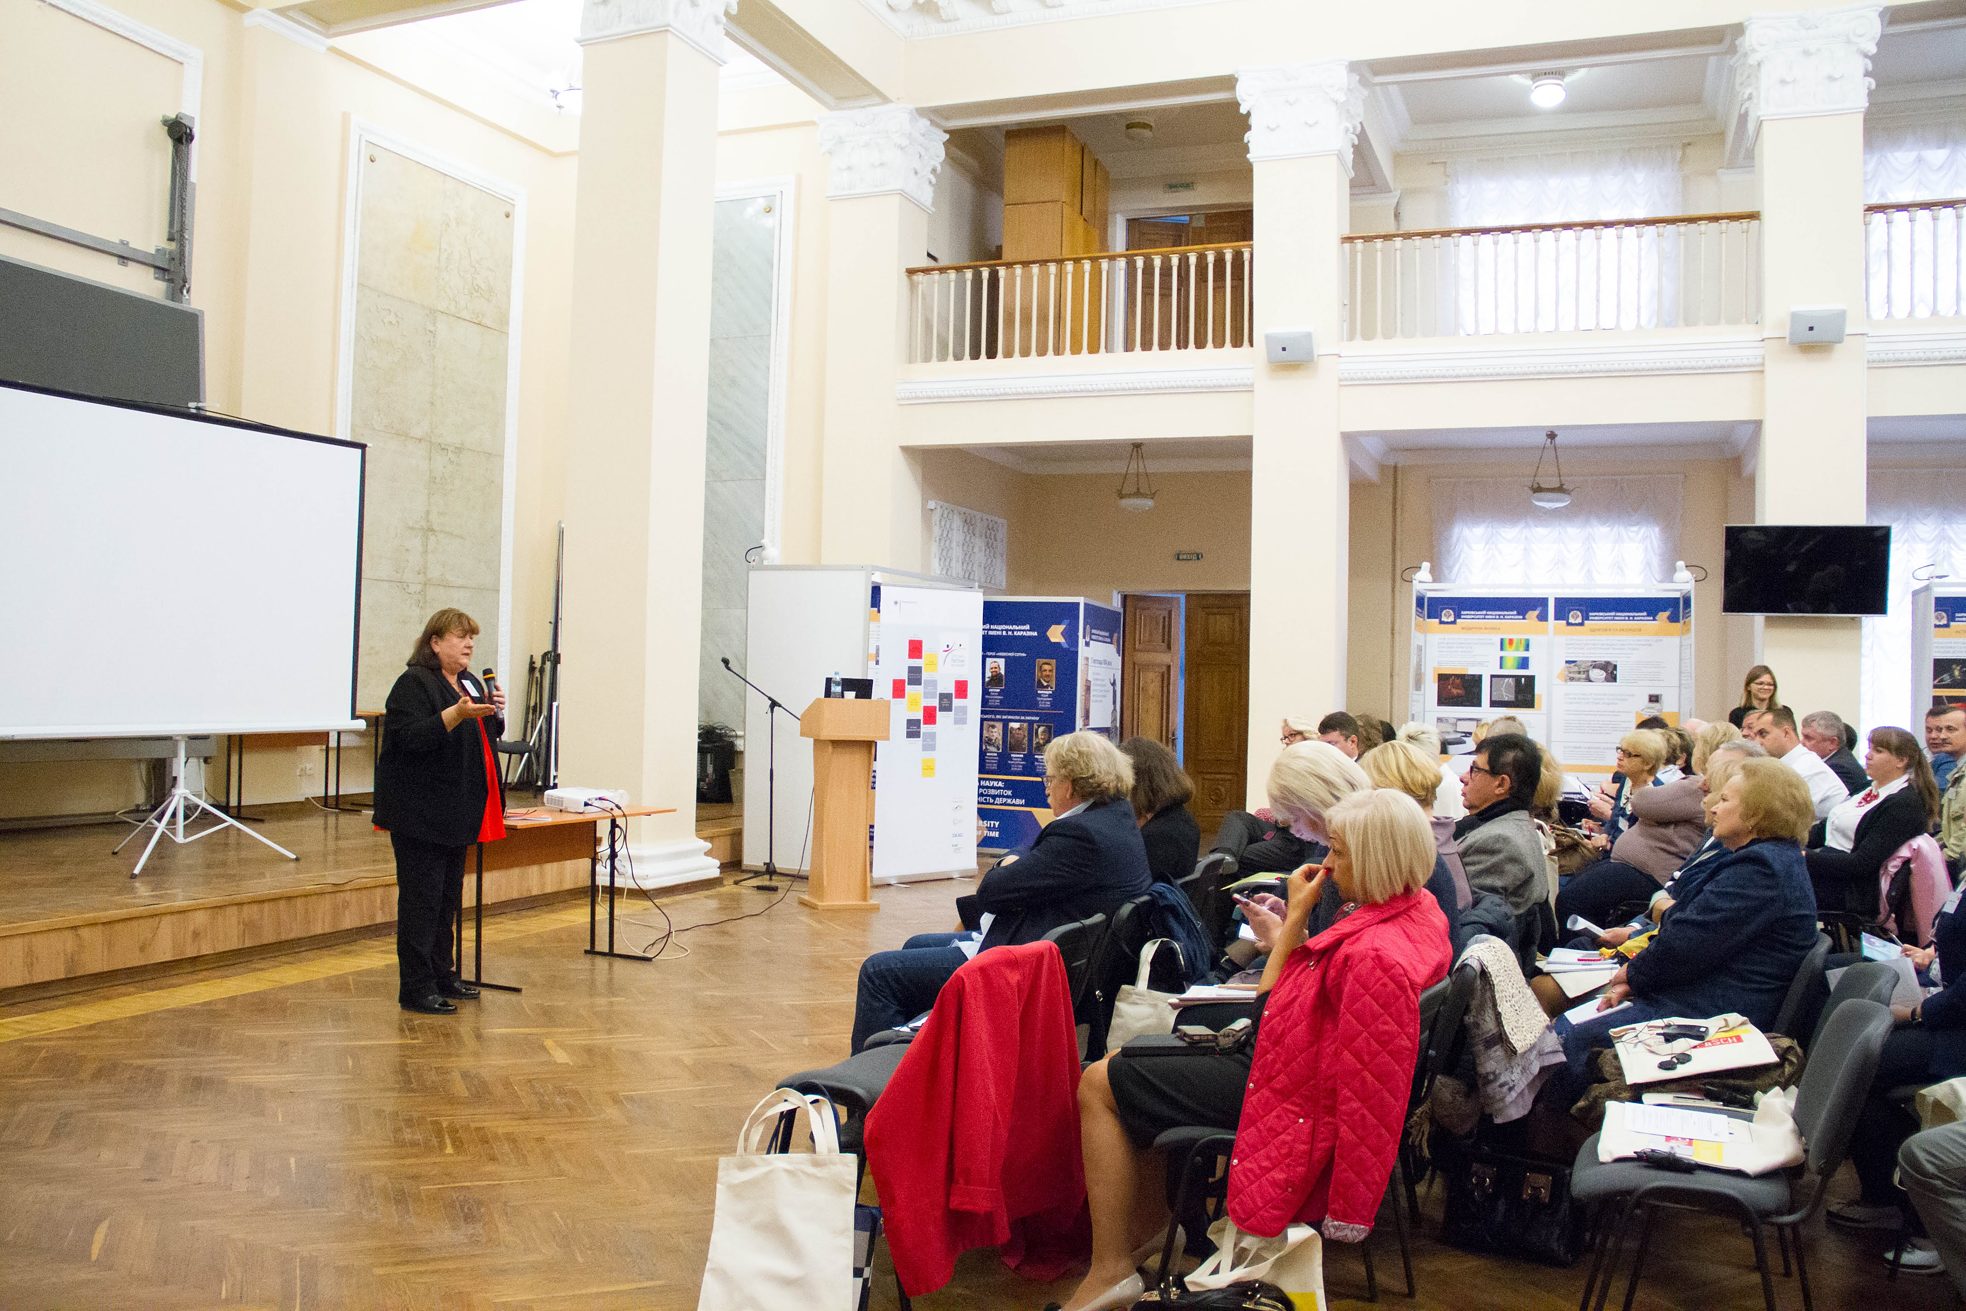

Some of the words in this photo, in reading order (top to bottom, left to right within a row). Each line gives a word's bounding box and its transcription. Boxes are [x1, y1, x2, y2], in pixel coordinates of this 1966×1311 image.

[978, 788, 1013, 796] РОЗВИТОК
[994, 797, 1025, 805] ДЕРЖАВИ
[983, 830, 1000, 838] TIME
[1697, 1037, 1737, 1049] ASCH
